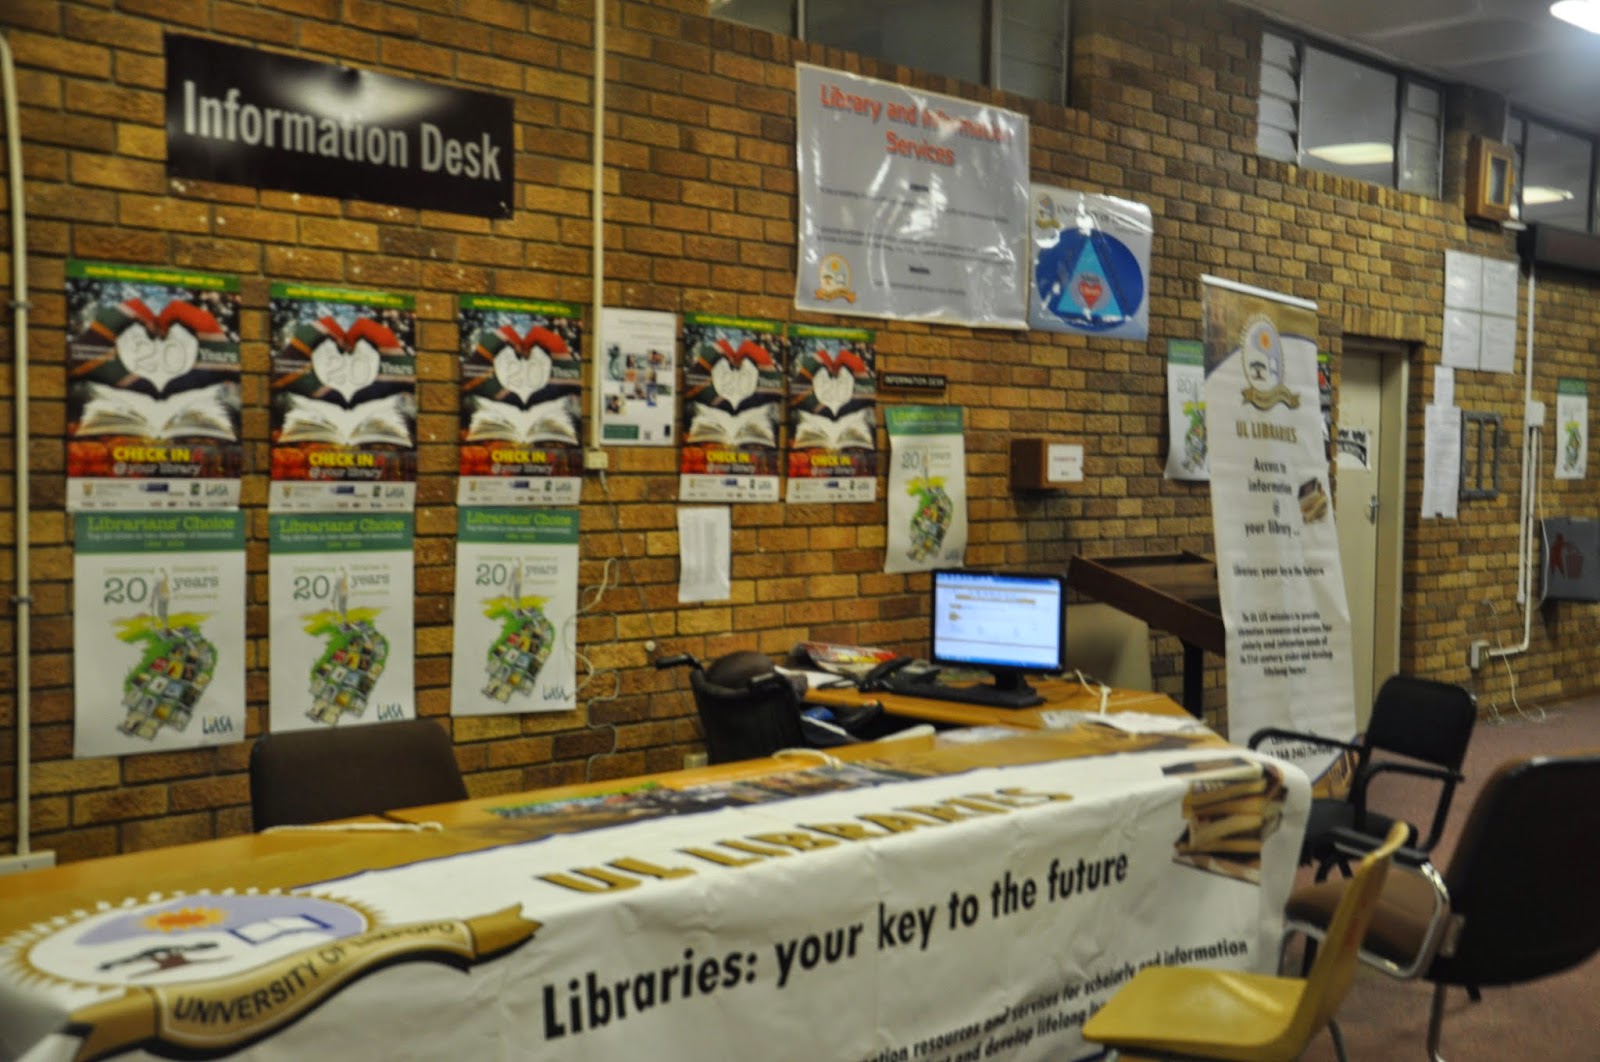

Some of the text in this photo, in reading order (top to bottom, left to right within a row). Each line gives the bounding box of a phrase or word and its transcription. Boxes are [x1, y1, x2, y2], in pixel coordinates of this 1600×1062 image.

[819, 84, 883, 124] Library
[887, 102, 917, 126] and
[183, 79, 502, 182] Information Desk
[885, 130, 955, 167] Services
[113, 446, 191, 463] CHECK IN
[309, 451, 374, 467] CHECK IN
[491, 449, 547, 464] CHECK IN
[183, 515, 236, 531] Choice
[172, 575, 219, 591] years
[293, 575, 330, 600] 20
[351, 573, 391, 588] years
[475, 563, 507, 586] 20
[103, 576, 148, 604] 20
[532, 856, 698, 895] UL
[542, 853, 1129, 1041] Libraries: your key to the future
[173, 960, 320, 1025] UNIVERSITY
[913, 1022, 981, 1058] resources
[983, 1004, 1011, 1033] and
[1062, 983, 1081, 1002] for
[1164, 939, 1248, 967] information
[985, 1027, 1033, 1057] develop
[1037, 1010, 1086, 1037] lifelong
